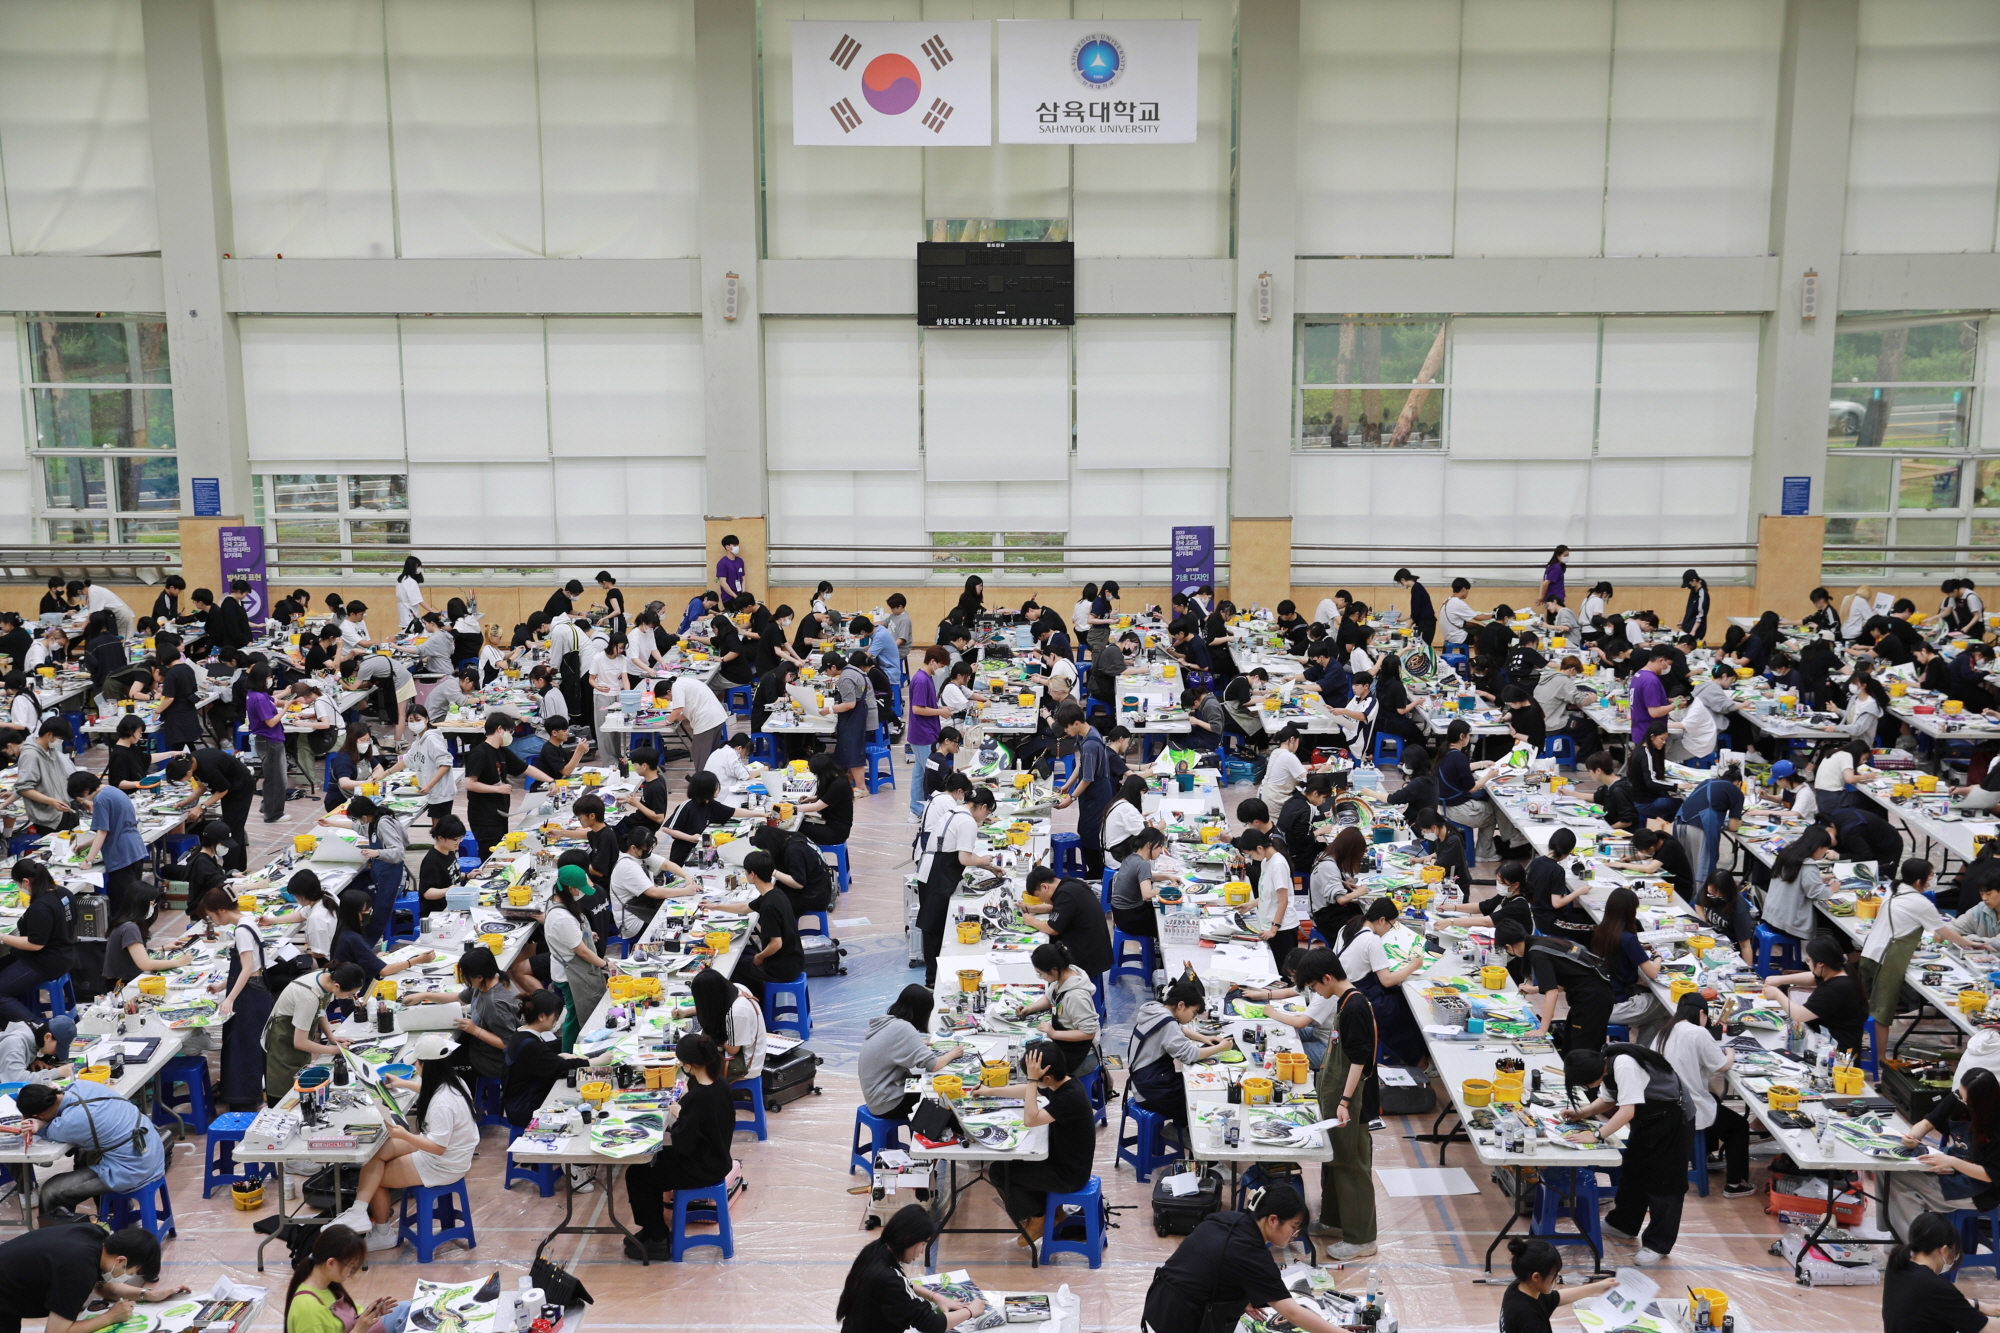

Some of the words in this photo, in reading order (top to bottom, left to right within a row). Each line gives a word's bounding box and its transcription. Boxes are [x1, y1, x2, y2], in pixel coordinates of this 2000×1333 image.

[1071, 34, 1096, 72] SAHMYOOK
[1100, 34, 1126, 72] UNIVERSITY
[1035, 100, 1161, 123] 삼육대학교
[1039, 124, 1096, 134] SAHMYOOK
[1100, 124, 1160, 134] UNIVERSITY
[227, 574, 247, 582] 발상과
[1175, 574, 1189, 582] 기초
[1190, 573, 1209, 582] 디자인
